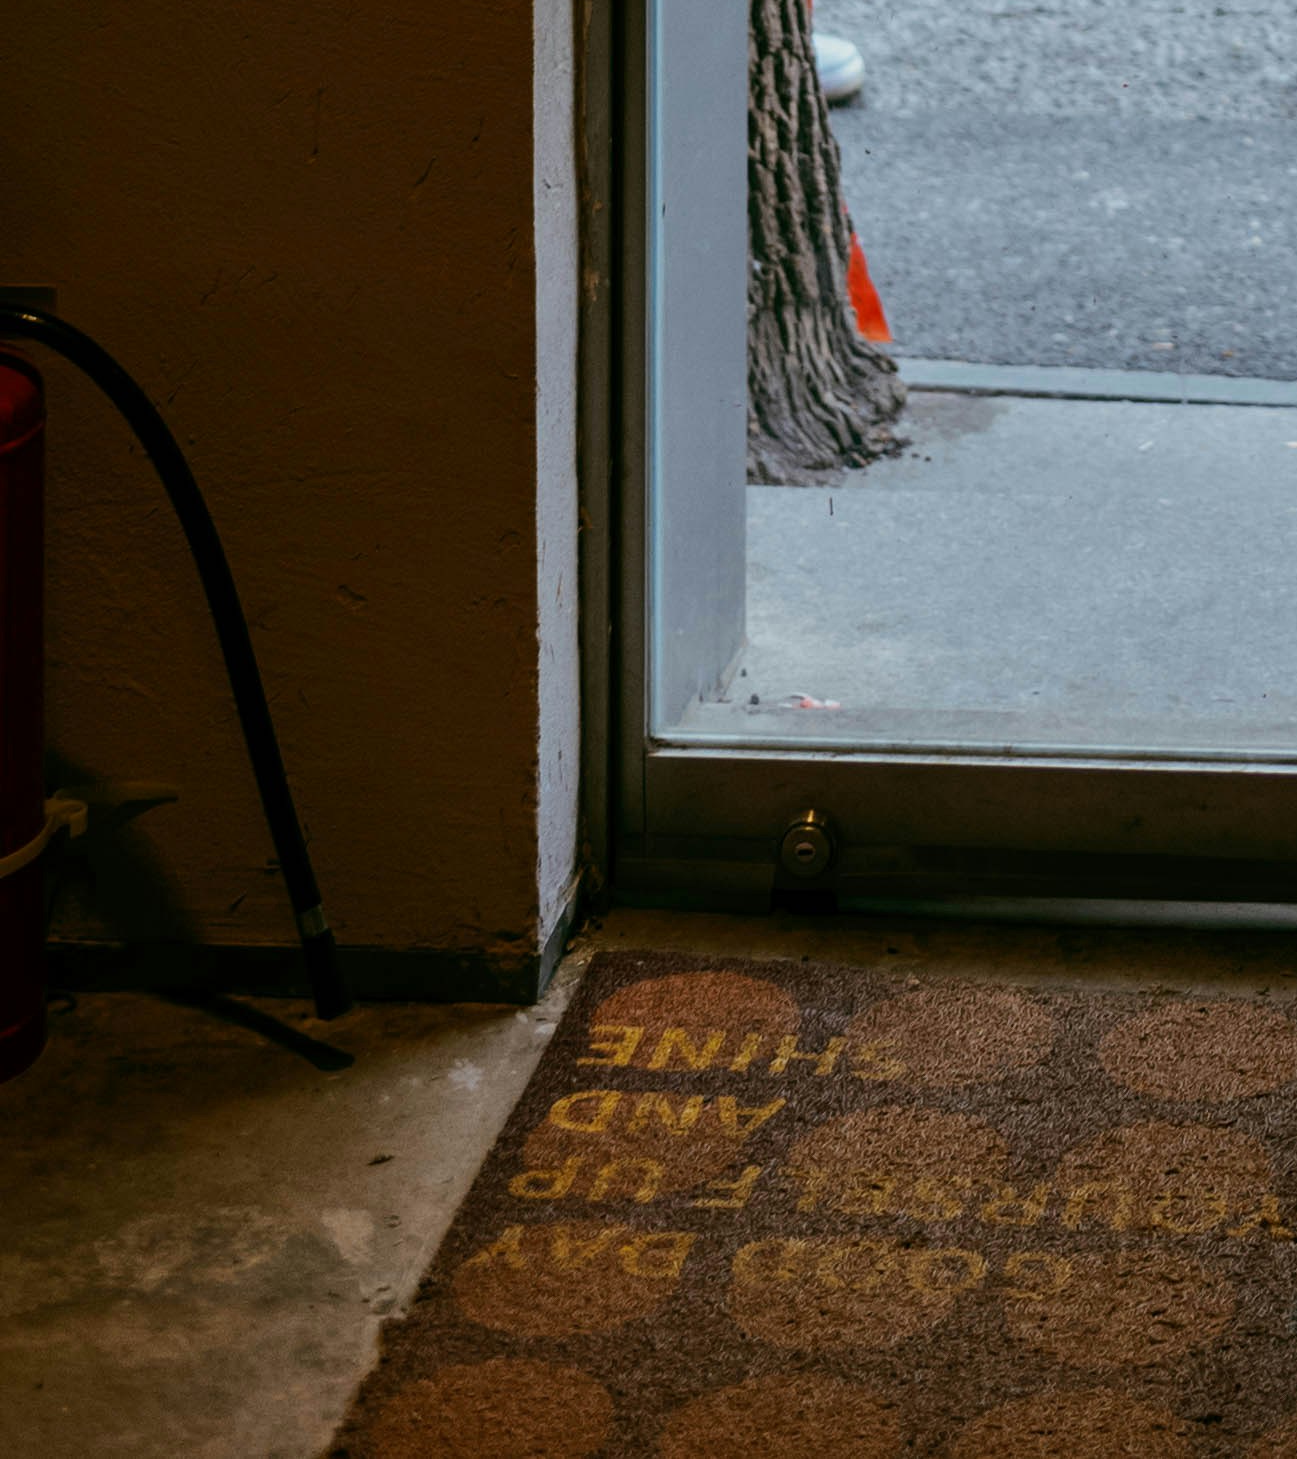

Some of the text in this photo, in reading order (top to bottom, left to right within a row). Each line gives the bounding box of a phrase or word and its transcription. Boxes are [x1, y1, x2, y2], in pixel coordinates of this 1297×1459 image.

[577, 1022, 906, 1081] SHINE
[543, 1088, 787, 1140] AND
[506, 1155, 664, 1205] UP
[449, 1224, 1072, 1299] GOOD DAY
